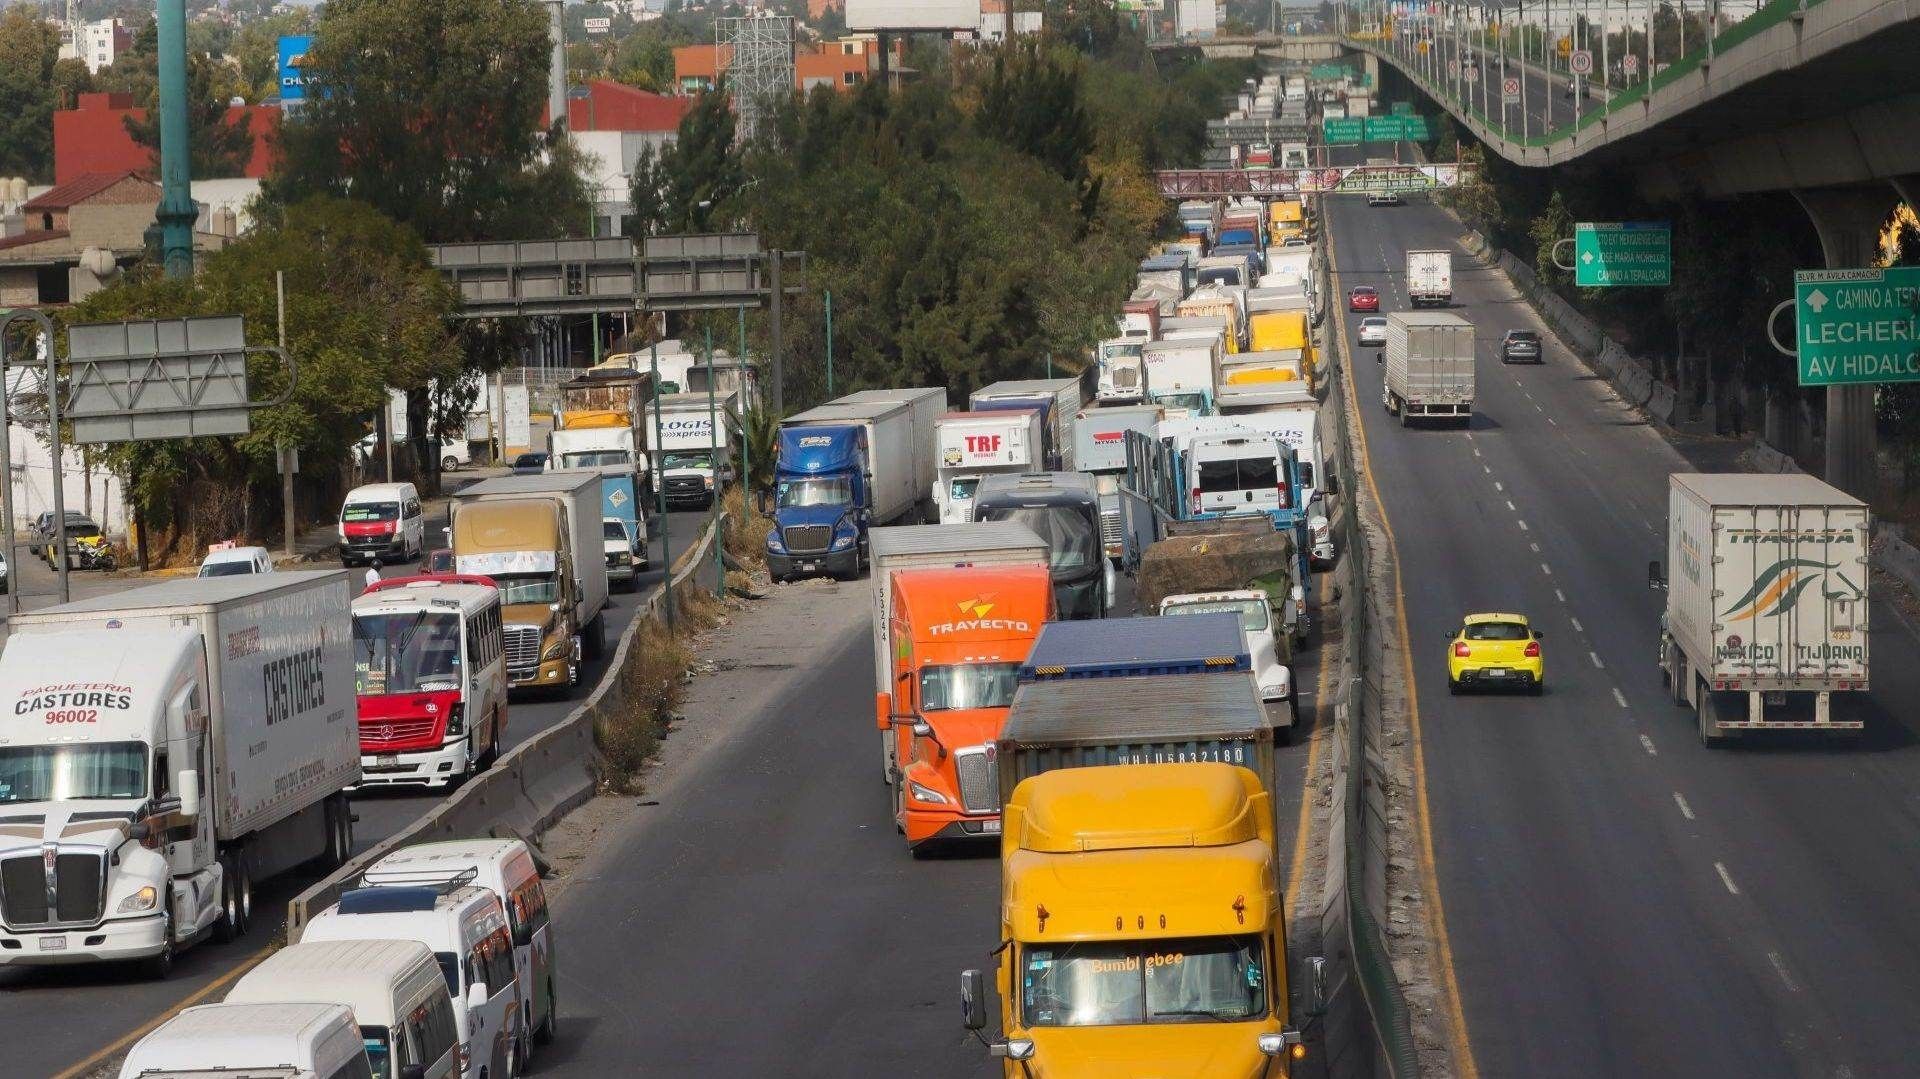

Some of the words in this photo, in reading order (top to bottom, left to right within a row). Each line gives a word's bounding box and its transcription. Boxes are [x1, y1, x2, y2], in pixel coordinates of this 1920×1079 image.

[1597, 269, 1623, 281] CAMINO
[1847, 270, 1880, 278] CAMACHO
[1836, 287, 1881, 309] CAMINO
[1884, 288, 1893, 308] A
[1895, 286, 1920, 308] TEP
[1808, 356, 1837, 377] AV
[965, 435, 1001, 452] TRF
[1726, 528, 1855, 543] TRACASA
[928, 619, 1029, 636] TRAYECTO
[1799, 645, 1863, 660] TIJUANA
[263, 646, 325, 726] CASTORES
[15, 692, 131, 715] CASTORES
[45, 709, 97, 724] 96002
[1092, 952, 1184, 973] Bumblebee
